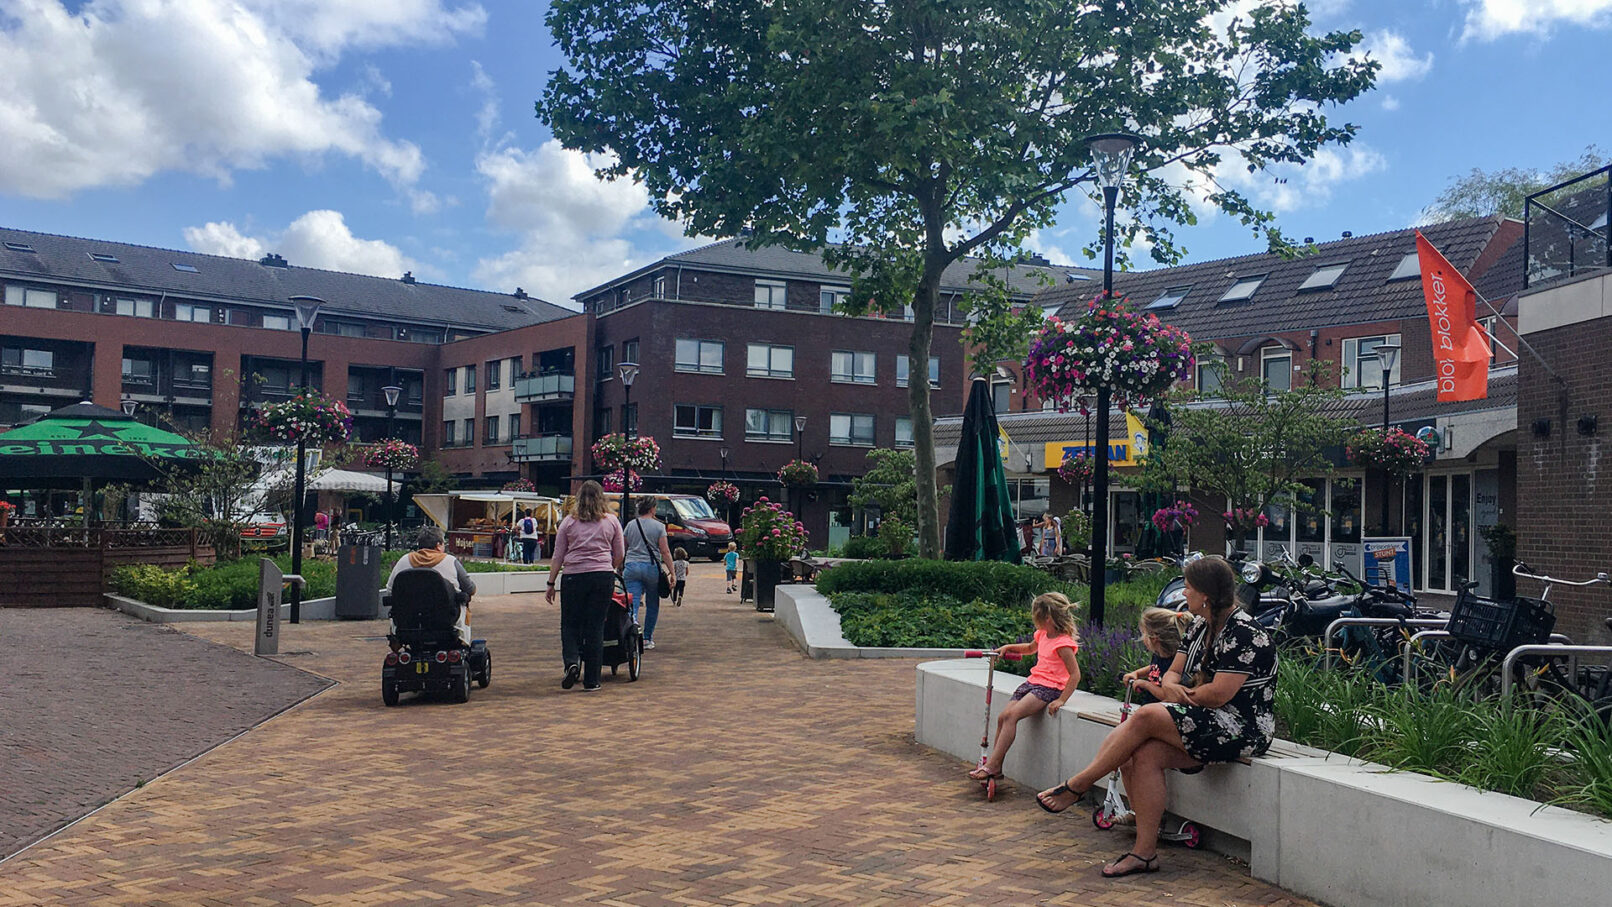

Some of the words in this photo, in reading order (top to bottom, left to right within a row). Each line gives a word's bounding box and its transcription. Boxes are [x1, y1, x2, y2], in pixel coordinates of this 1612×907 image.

[1431, 272, 1453, 351] blokker
[0, 441, 226, 459] eineke
[1477, 493, 1496, 506] Enjoy
[1375, 549, 1395, 558] STUNT
[263, 608, 275, 638] dunea
